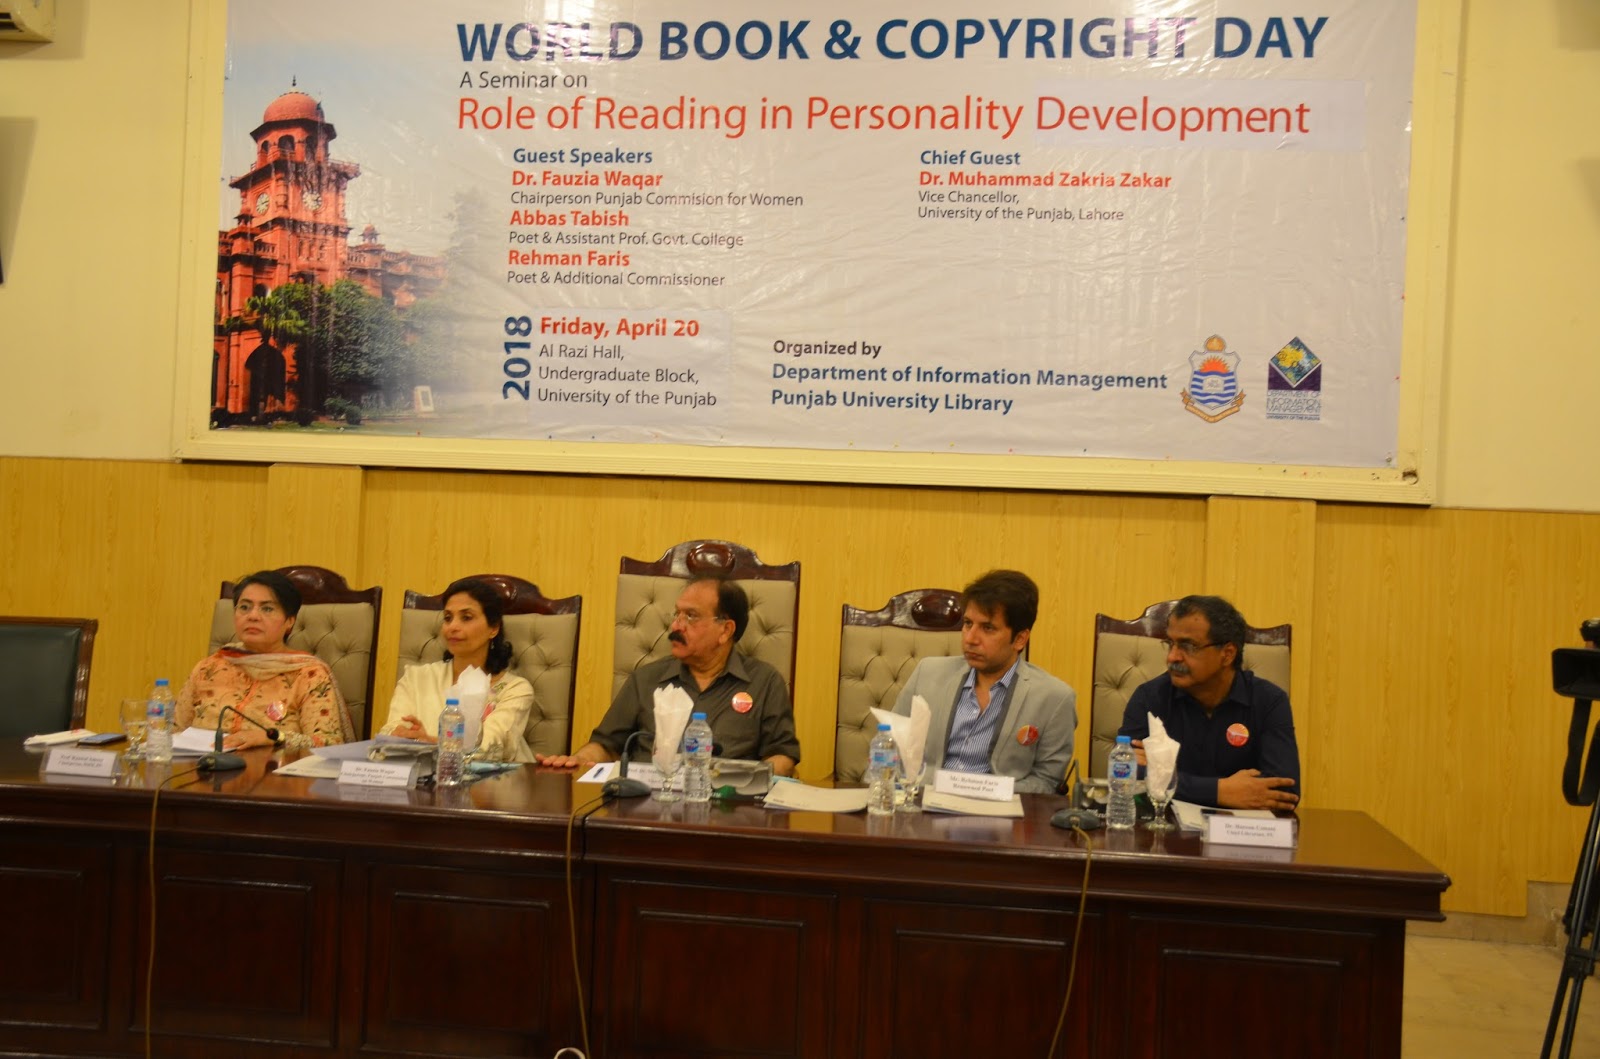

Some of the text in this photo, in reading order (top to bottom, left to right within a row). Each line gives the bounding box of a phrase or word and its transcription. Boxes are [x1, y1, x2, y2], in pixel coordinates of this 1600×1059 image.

[457, 17, 1328, 62] WORLD BOOK & COPYRIGHT DAY
[460, 71, 587, 88] A Seminar on
[459, 95, 1310, 141] Role of Reading in Personality Development
[514, 148, 652, 167] Guest Speakers
[921, 150, 1020, 165] Chief Guest
[513, 171, 663, 190] Dr. Fauzia Waqar
[920, 171, 1171, 187] Dr. Muhammad Zakria Zakar
[511, 191, 803, 207] Chairperson Punjab Commision for Women
[919, 191, 1019, 204] Vice Chancellor,
[510, 210, 628, 226] Abbas Tabish
[918, 207, 1124, 222] University of the Punjab, Lahore
[510, 231, 743, 249] Poet & Assistant Prof. Govt. College
[509, 250, 629, 266] Rehman Faris
[508, 271, 725, 286] Poet & Additional Commissioner
[541, 317, 699, 340] Friday, April 20
[503, 316, 532, 400] 2018
[539, 344, 624, 360] Al Razi Hall,
[774, 340, 881, 359] Organized by
[539, 366, 698, 384] Undergraduate Block,
[773, 364, 1167, 391] Department of Information Management
[538, 388, 716, 408] University of the Punjab
[772, 390, 1013, 415] Punjab University Library
